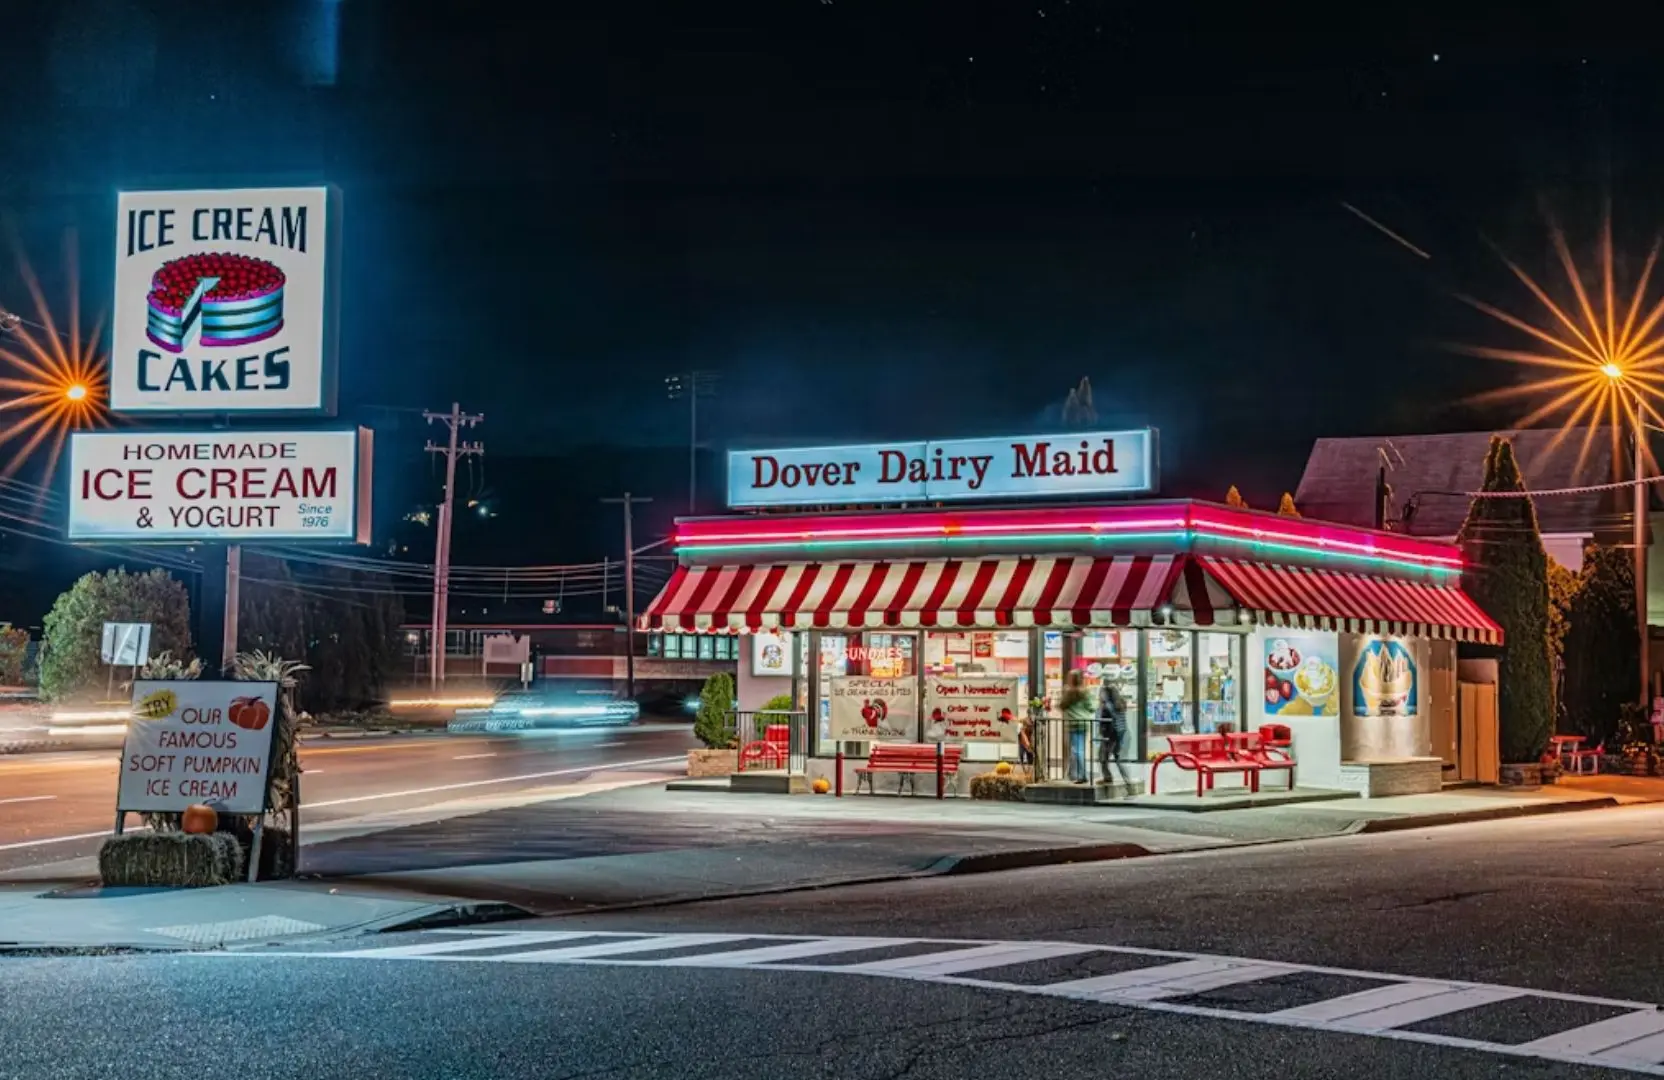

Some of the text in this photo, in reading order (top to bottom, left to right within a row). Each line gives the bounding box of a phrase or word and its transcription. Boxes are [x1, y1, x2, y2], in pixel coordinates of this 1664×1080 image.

[127, 206, 308, 257] ICE CREAM
[137, 346, 290, 391] CAKES
[123, 442, 297, 460] HOMEMADE
[751, 439, 1118, 489] Dover Dairy Maid
[82, 467, 337, 500] ICE CREAM
[136, 506, 280, 528] & YOGURT
[298, 503, 332, 514] Since
[302, 516, 329, 528] 1976
[849, 680, 898, 688] SPECIAL
[936, 684, 1010, 696] Open November
[143, 695, 171, 717] TRY
[181, 707, 221, 724] OUR
[947, 704, 991, 713] Order Your
[158, 730, 237, 749] FAMOUS
[129, 754, 261, 775] SOFT PUMPKIN
[146, 778, 238, 798] ICE CREAM
